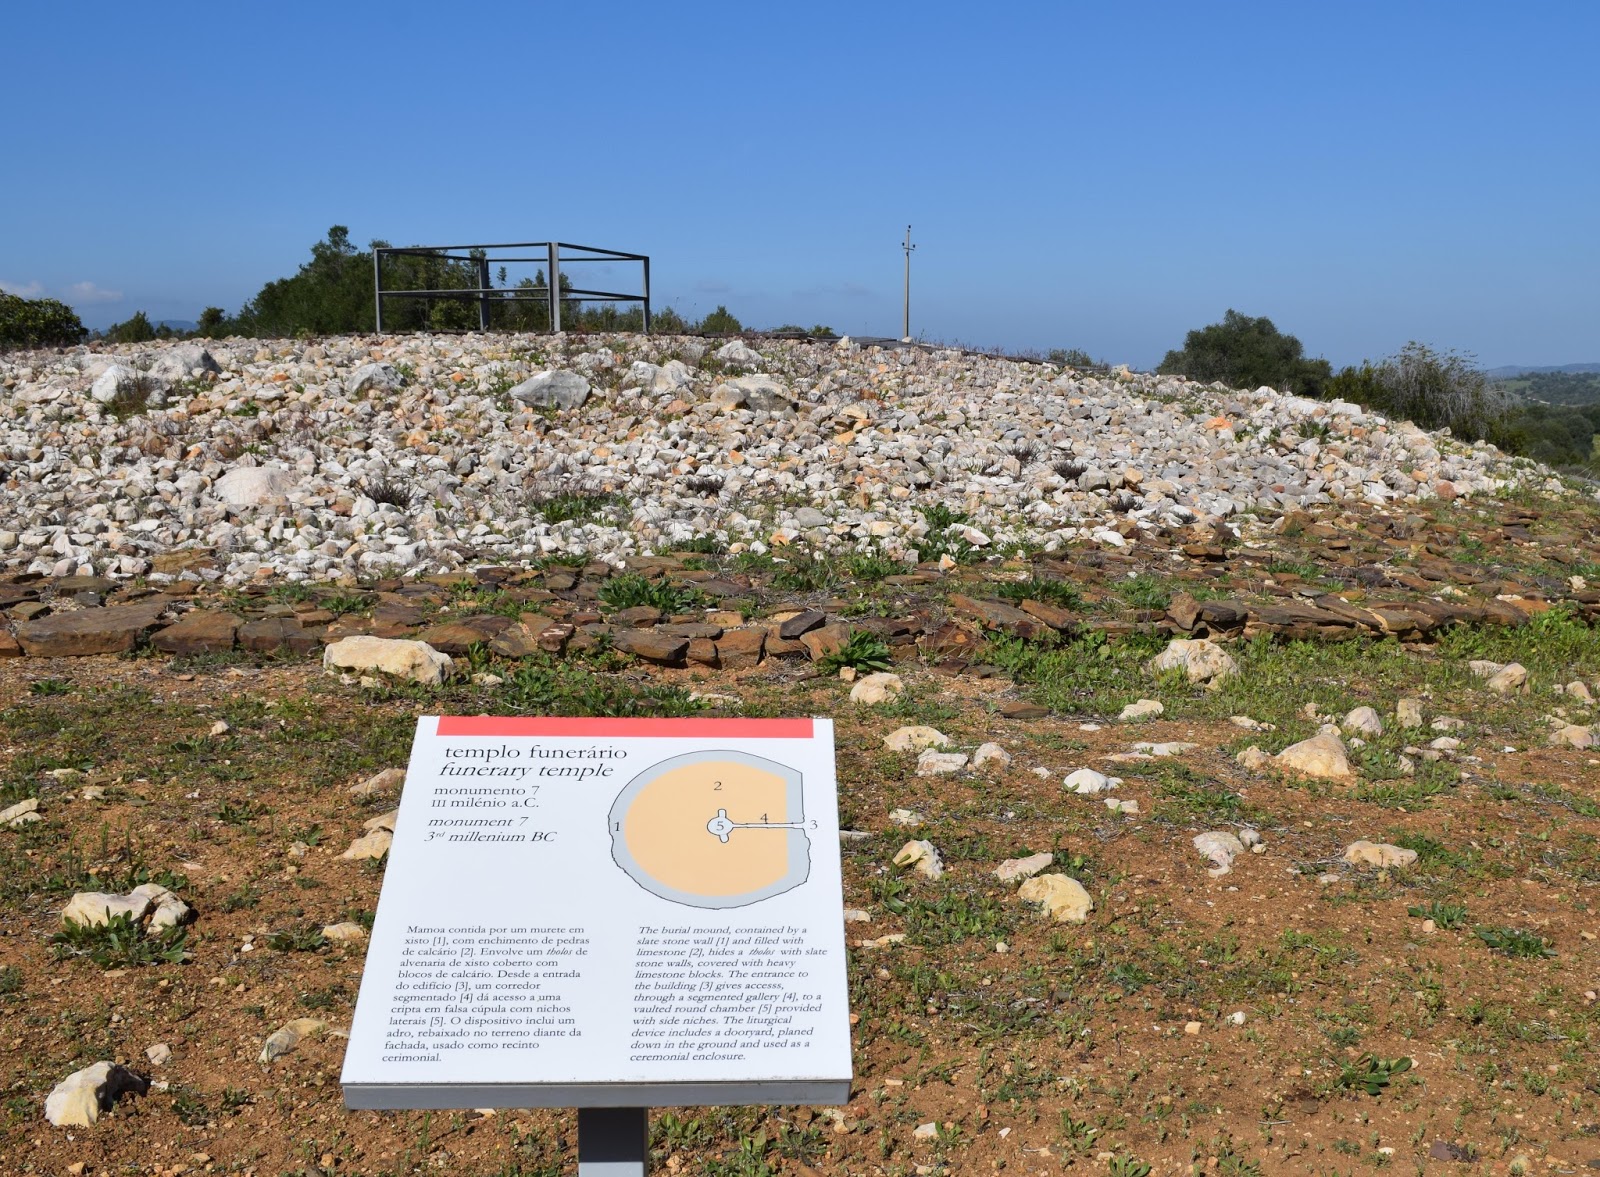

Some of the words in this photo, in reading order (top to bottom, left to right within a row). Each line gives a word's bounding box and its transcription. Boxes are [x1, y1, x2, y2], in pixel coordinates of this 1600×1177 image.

[445, 744, 521, 763] templo
[528, 744, 628, 759] funerário
[438, 761, 533, 781] funerary
[538, 762, 614, 782] temple
[434, 787, 526, 796] monumento
[531, 785, 540, 795] 7
[714, 781, 722, 791] 2
[431, 799, 447, 808] III
[450, 797, 507, 808] milénio
[511, 797, 539, 808] a.C.
[428, 818, 514, 827] monument
[519, 816, 529, 826] 7
[760, 813, 768, 824] 4
[614, 821, 620, 832] 1
[716, 821, 725, 831] 5
[810, 820, 818, 830] 3
[448, 831, 526, 842] millenium
[530, 831, 558, 842] BC
[407, 925, 445, 934] Mamoa
[448, 925, 486, 934] contida
[489, 928, 508, 936] por
[639, 926, 659, 934] The
[661, 926, 691, 934] burial
[692, 926, 731, 935] mound,
[734, 926, 785, 934] contained
[786, 926, 799, 936] by
[404, 936, 430, 944] xisto
[432, 936, 449, 947] [1],
[478, 936, 539, 944] enchimento
[541, 936, 554, 944] de
[556, 936, 590, 947] pedras
[636, 937, 660, 945] slate
[693, 937, 714, 945] wall
[715, 936, 730, 947] [1]
[732, 936, 752, 945] and
[754, 936, 780, 945] filled
[782, 936, 804, 944] with
[402, 947, 415, 956] de
[417, 947, 457, 956] calcário
[460, 947, 476, 958] [2].
[480, 947, 524, 956] Envolve
[546, 947, 573, 956] tholos
[575, 947, 588, 956] de
[636, 948, 686, 956] limestone
[688, 948, 705, 958] [2],
[708, 947, 735, 956] hides
[748, 947, 776, 956] tholos
[780, 947, 802, 956] with
[805, 947, 828, 955] slate
[400, 958, 446, 967] alvenaria
[448, 958, 462, 967] de
[464, 958, 490, 967] xisto
[492, 958, 533, 967] coberto
[667, 959, 694, 968] walls,
[697, 958, 739, 967] covered
[741, 958, 764, 967] with
[766, 958, 796, 969] heavy
[398, 970, 432, 978] blocos
[435, 970, 448, 978] de
[451, 970, 494, 978] calcário.
[497, 969, 531, 978] Desde
[542, 969, 581, 978] entrada
[634, 970, 686, 979] limestone
[688, 970, 724, 979] blocks.
[728, 970, 749, 978] The
[395, 981, 410, 990] do
[412, 981, 452, 990] edifício
[454, 981, 472, 992] [3],
[495, 981, 541, 990] corredor
[634, 981, 652, 990] the
[654, 981, 697, 992] building
[698, 981, 714, 992] [3]
[714, 981, 742, 992] gives
[393, 992, 457, 1004] segmentado
[459, 992, 474, 1004] [4]
[476, 992, 489, 1002] dá
[633, 993, 676, 1004] through
[687, 992, 744, 1004] segmented
[744, 992, 780, 1004] gallery
[782, 992, 799, 1003] [4],
[390, 1004, 421, 1016] cripta
[444, 1004, 468, 1013] falsa
[471, 1004, 506, 1016] cúpula
[536, 1004, 571, 1013] nichos
[634, 1004, 673, 1013] vaulted
[674, 1004, 708, 1013] round
[709, 1004, 756, 1013] chamber
[757, 1004, 773, 1015] [5]
[774, 1003, 822, 1015] provided
[389, 1016, 426, 1025] laterais
[430, 1016, 446, 1028] [5].
[450, 1016, 462, 1025] O
[464, 1016, 523, 1028] dispositivo
[525, 1016, 555, 1025] inclui
[633, 1016, 656, 1025] with
[658, 1016, 680, 1025] side
[682, 1016, 718, 1025] niches.
[723, 1016, 744, 1024] The
[746, 1015, 793, 1026] liturgical
[386, 1028, 414, 1038] adro,
[418, 1028, 470, 1037] rebaixado
[533, 1028, 566, 1037] diante
[568, 1027, 582, 1037] da
[631, 1028, 666, 1037] device
[668, 1027, 712, 1037] includes
[723, 1027, 775, 1038] dooryard,
[777, 1026, 814, 1038] planed
[384, 1040, 429, 1051] fachada,
[432, 1040, 465, 1050] usado
[467, 1042, 499, 1050] como
[502, 1040, 540, 1049] recinto
[630, 1040, 661, 1049] down
[664, 1040, 675, 1049] in
[678, 1040, 696, 1049] the
[696, 1039, 738, 1051] ground
[740, 1039, 761, 1048] and
[763, 1039, 788, 1048] used
[382, 1052, 442, 1062] cerimonial.
[629, 1052, 690, 1062] ceremonial
[692, 1051, 746, 1061] enclosure.
